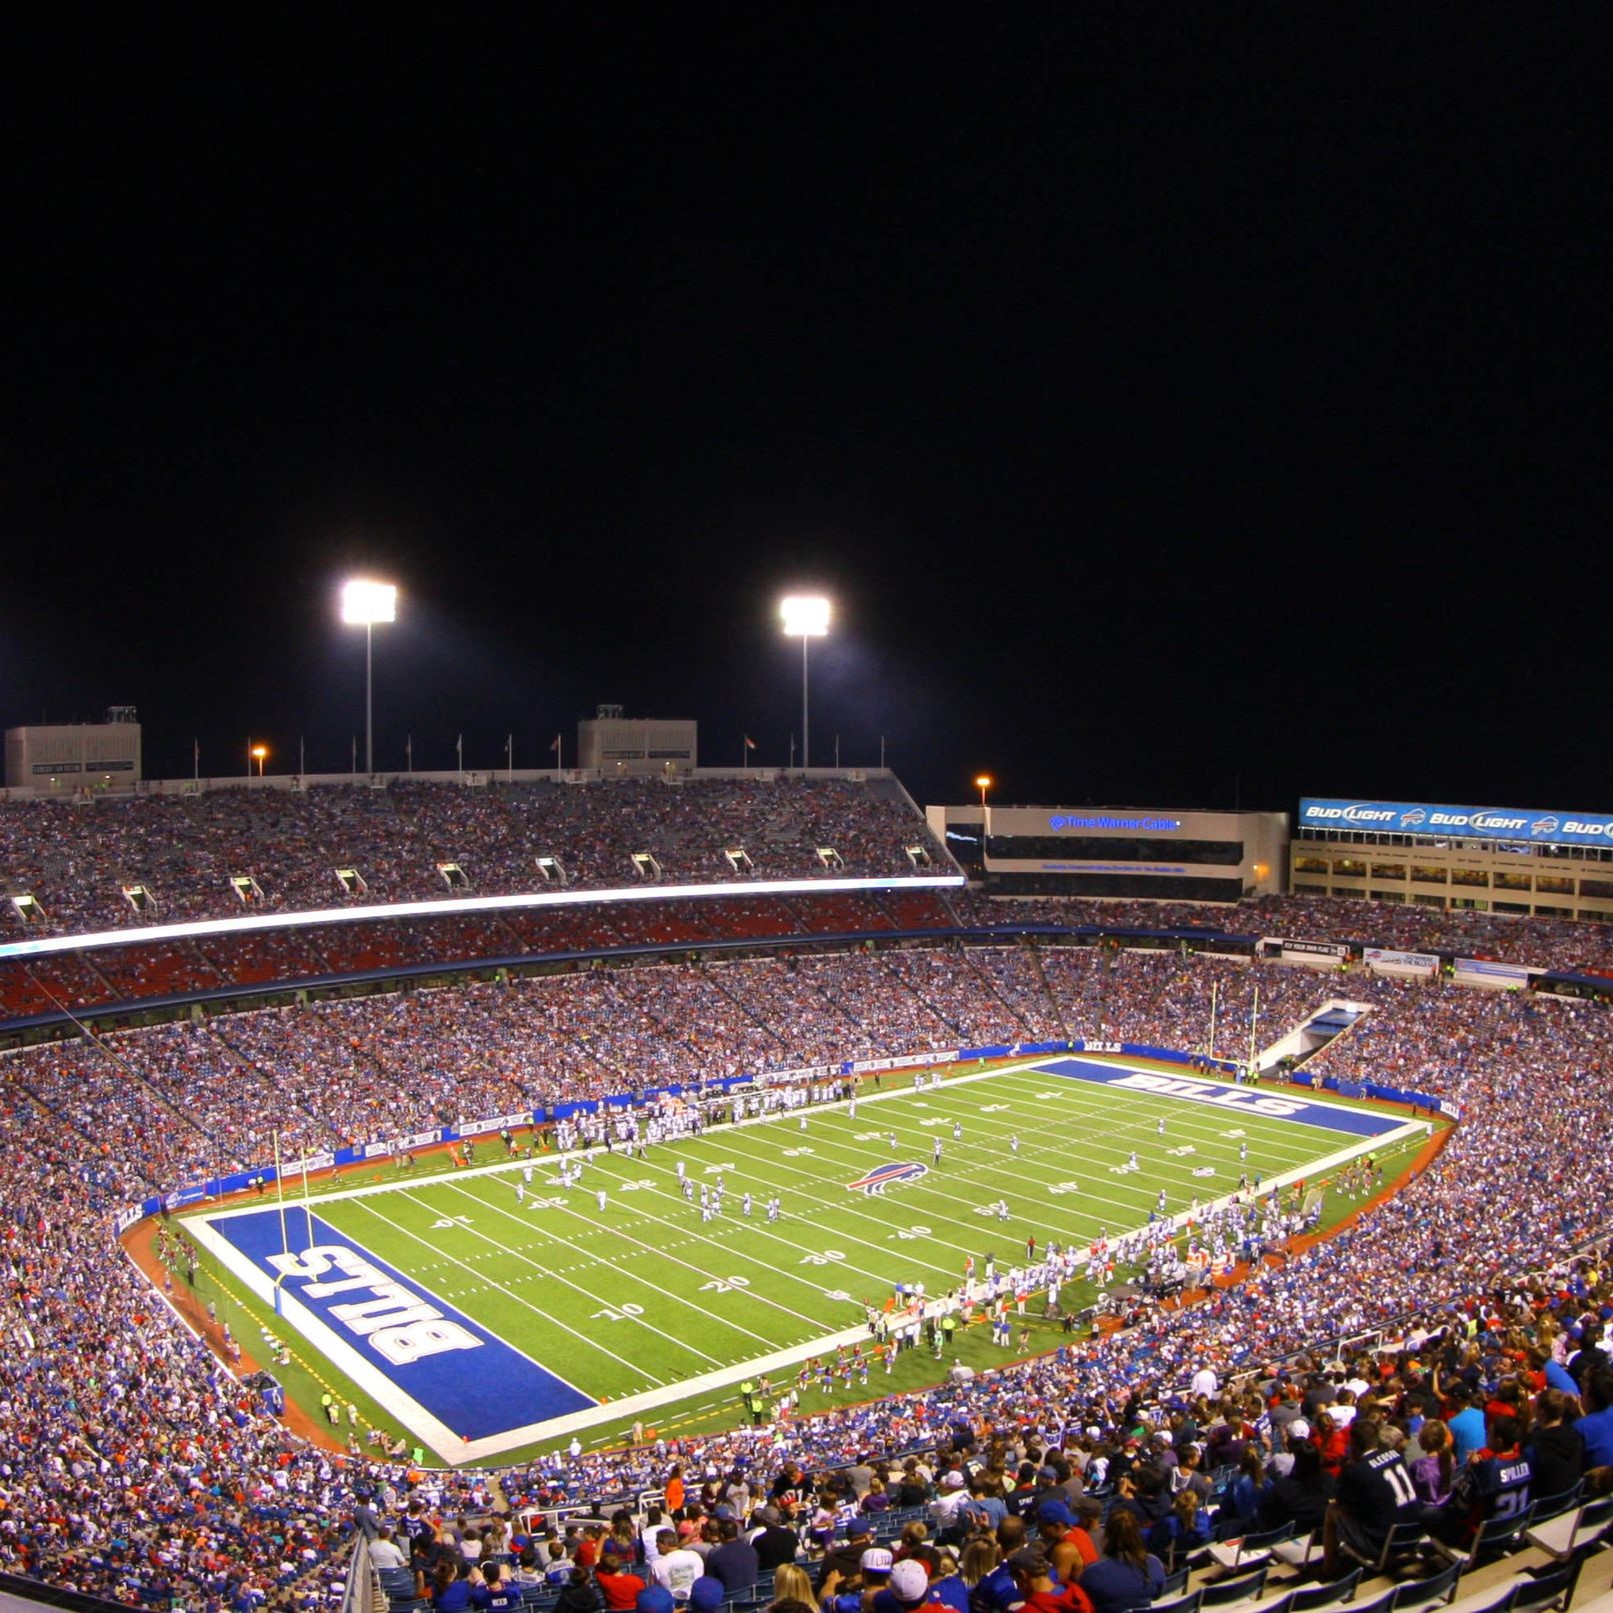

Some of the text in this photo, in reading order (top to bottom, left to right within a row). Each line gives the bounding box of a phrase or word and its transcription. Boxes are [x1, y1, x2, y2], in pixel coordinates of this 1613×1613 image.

[1305, 806, 1397, 821] BUD LIGHT
[1429, 812, 1527, 830] BUD LIGHT
[1066, 815, 1176, 831] Time Warner Cable
[1562, 821, 1604, 835] BUD
[1107, 1073, 1310, 1116] BILLS
[898, 1226, 932, 1239] 40
[803, 1250, 846, 1265] 30
[706, 1276, 750, 1293] 20
[265, 1245, 485, 1366] BILLS
[600, 1303, 645, 1321] 10
[1383, 1463, 1417, 1507] 11
